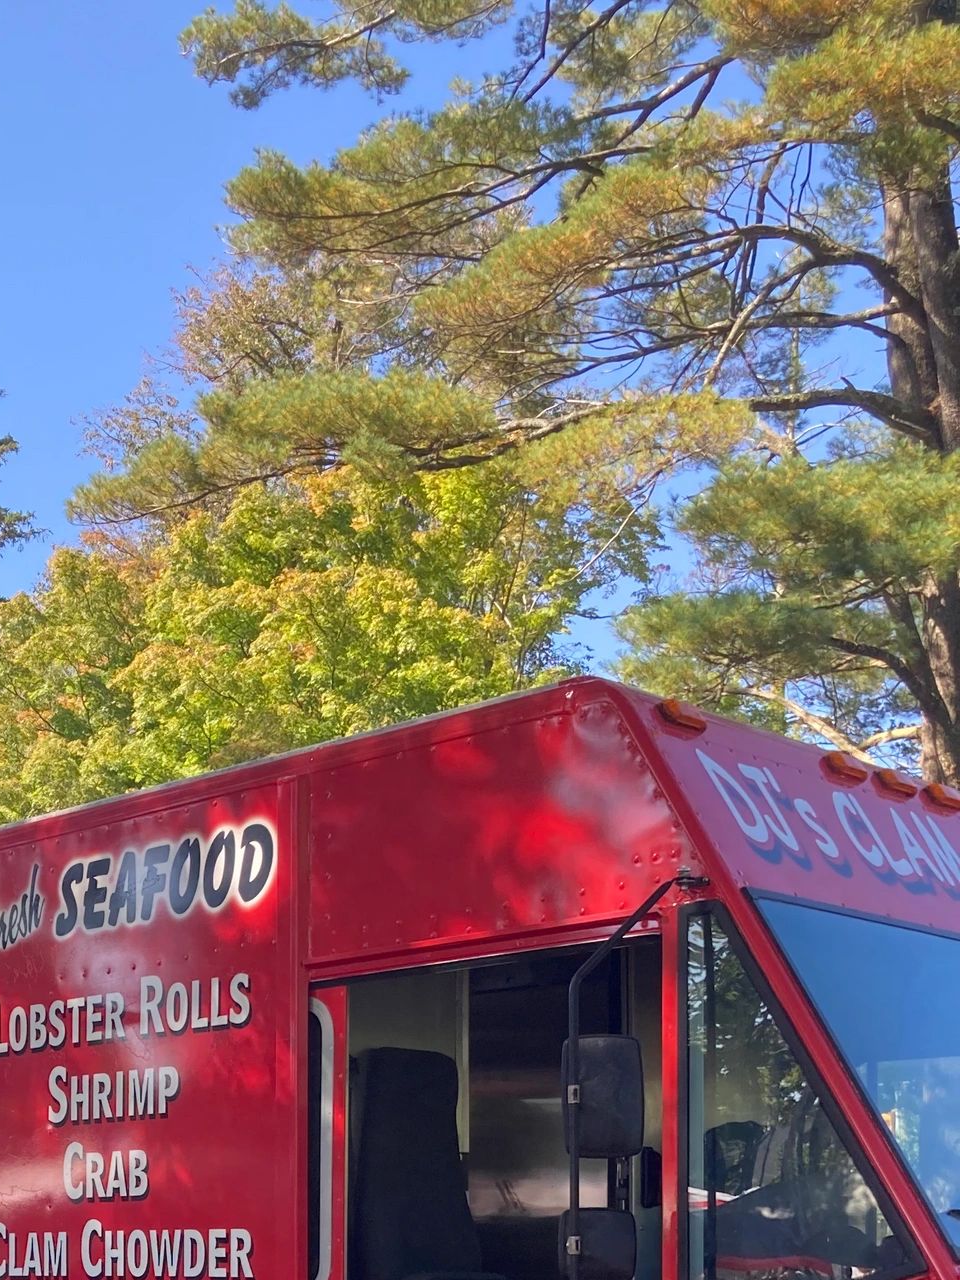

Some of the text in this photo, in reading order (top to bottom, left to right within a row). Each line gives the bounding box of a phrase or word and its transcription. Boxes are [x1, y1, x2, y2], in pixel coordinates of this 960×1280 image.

[696, 748, 839, 858] DJ's
[54, 822, 275, 938] SEAFOOD
[139, 973, 251, 1036] ROLLS
[47, 1065, 180, 1125] SHRIMP
[62, 1141, 150, 1201] CRAB
[80, 1218, 256, 1280] CHOWDER
